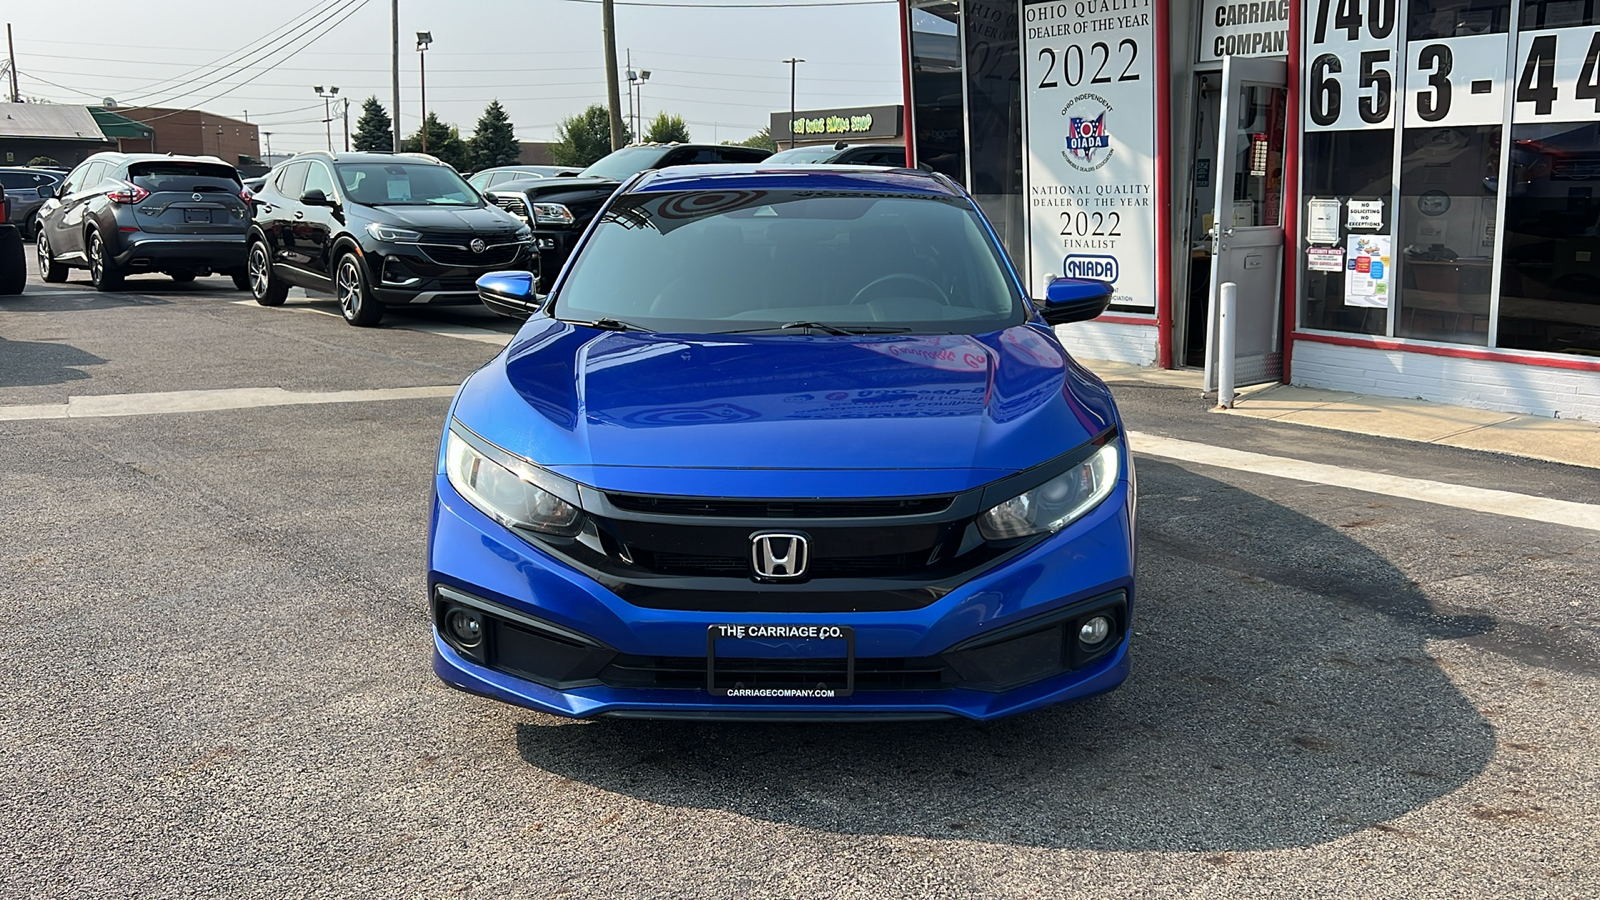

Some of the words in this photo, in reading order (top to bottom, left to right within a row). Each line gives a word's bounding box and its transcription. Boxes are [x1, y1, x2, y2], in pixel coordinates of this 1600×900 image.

[1026, 4, 1067, 22] OHIO
[1214, 0, 1289, 27] CARRIAG
[1028, 23, 1071, 39] DEALER
[1073, 20, 1088, 34] OF
[1090, 17, 1114, 32] THE
[1117, 13, 1149, 29] YEAR
[1038, 38, 1140, 89] 2022
[1061, 99, 1075, 116] OHIO
[1074, 92, 1114, 113] INDEPENDENT
[850, 113, 873, 131] SHOP
[1070, 136, 1102, 148] OIADA
[1032, 185, 1091, 196] NATIONAL
[1096, 184, 1151, 196] QUALITY
[1033, 198, 1073, 207] DEALER
[1076, 198, 1090, 207] OF
[1094, 197, 1116, 207] THE
[1120, 197, 1149, 207] YEAR
[1060, 211, 1122, 237] 2022
[1064, 239, 1116, 249] FINALIST
[1068, 260, 1113, 278] NIADA
[719, 625, 745, 637] THE
[749, 626, 817, 637] CARRIAGE
[819, 626, 843, 638] CO.
[727, 688, 835, 698] CARRIAGECOMPANY.COM
